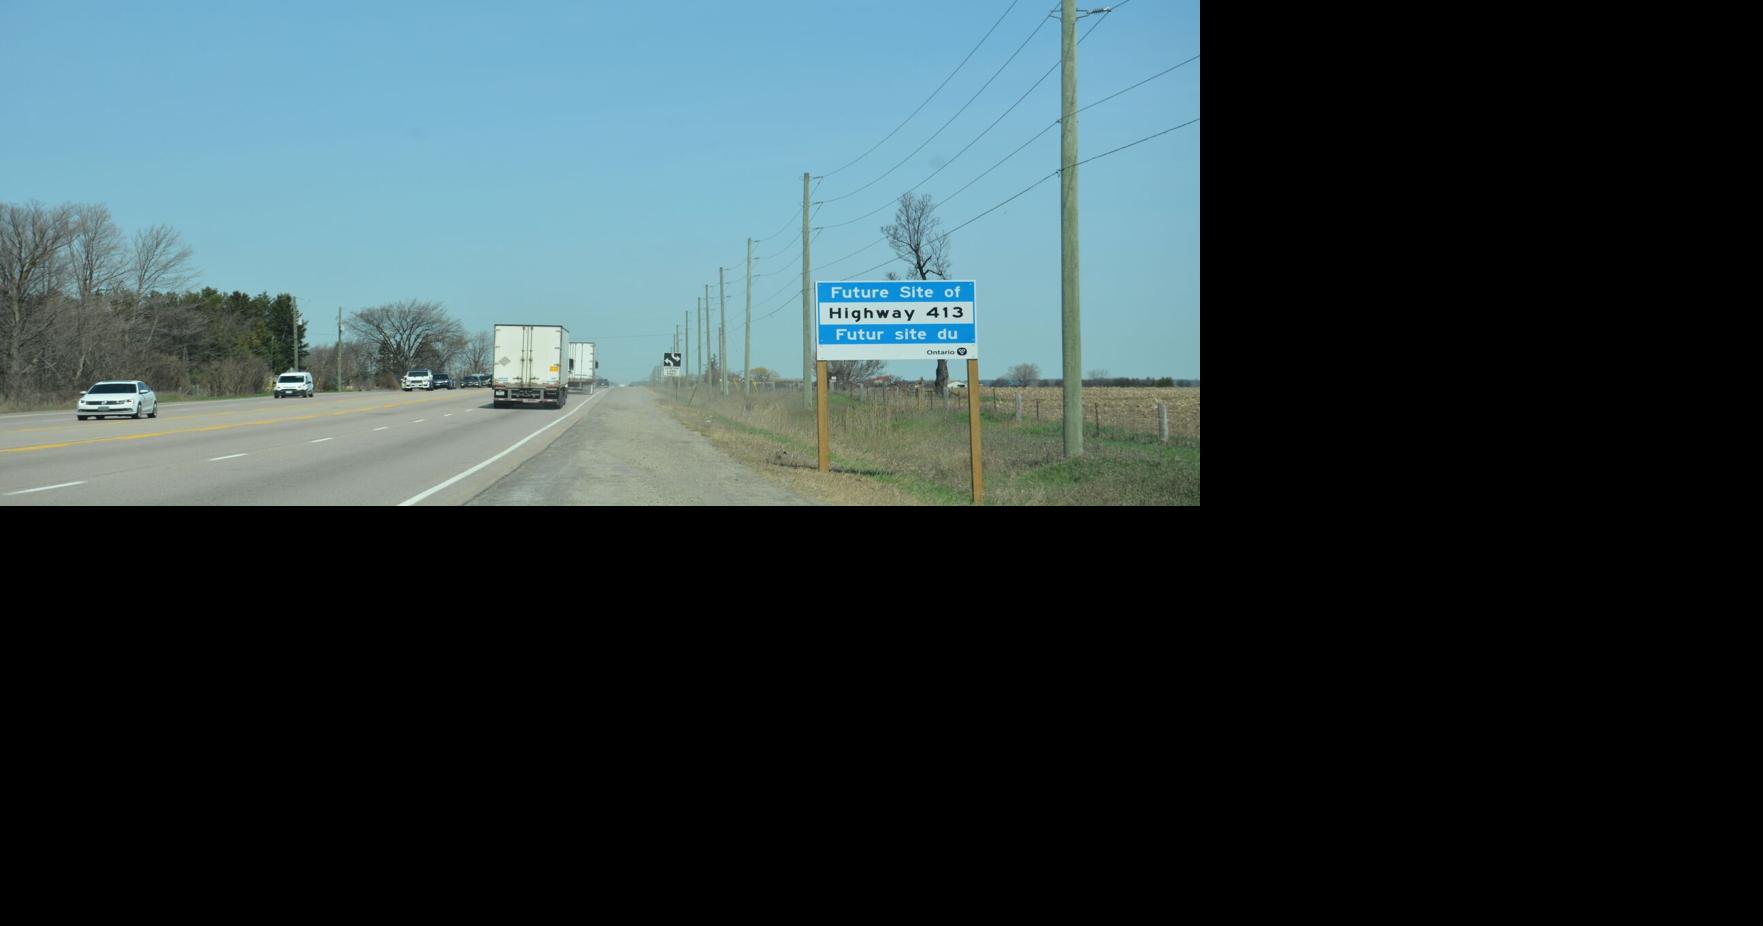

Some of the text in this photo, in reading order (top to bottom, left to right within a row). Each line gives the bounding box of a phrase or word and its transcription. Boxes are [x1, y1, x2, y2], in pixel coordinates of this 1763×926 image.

[831, 286, 961, 299] Future Site of
[829, 307, 964, 322] Highway 413
[836, 328, 958, 341] Futur site du
[926, 348, 956, 356] Ontario
